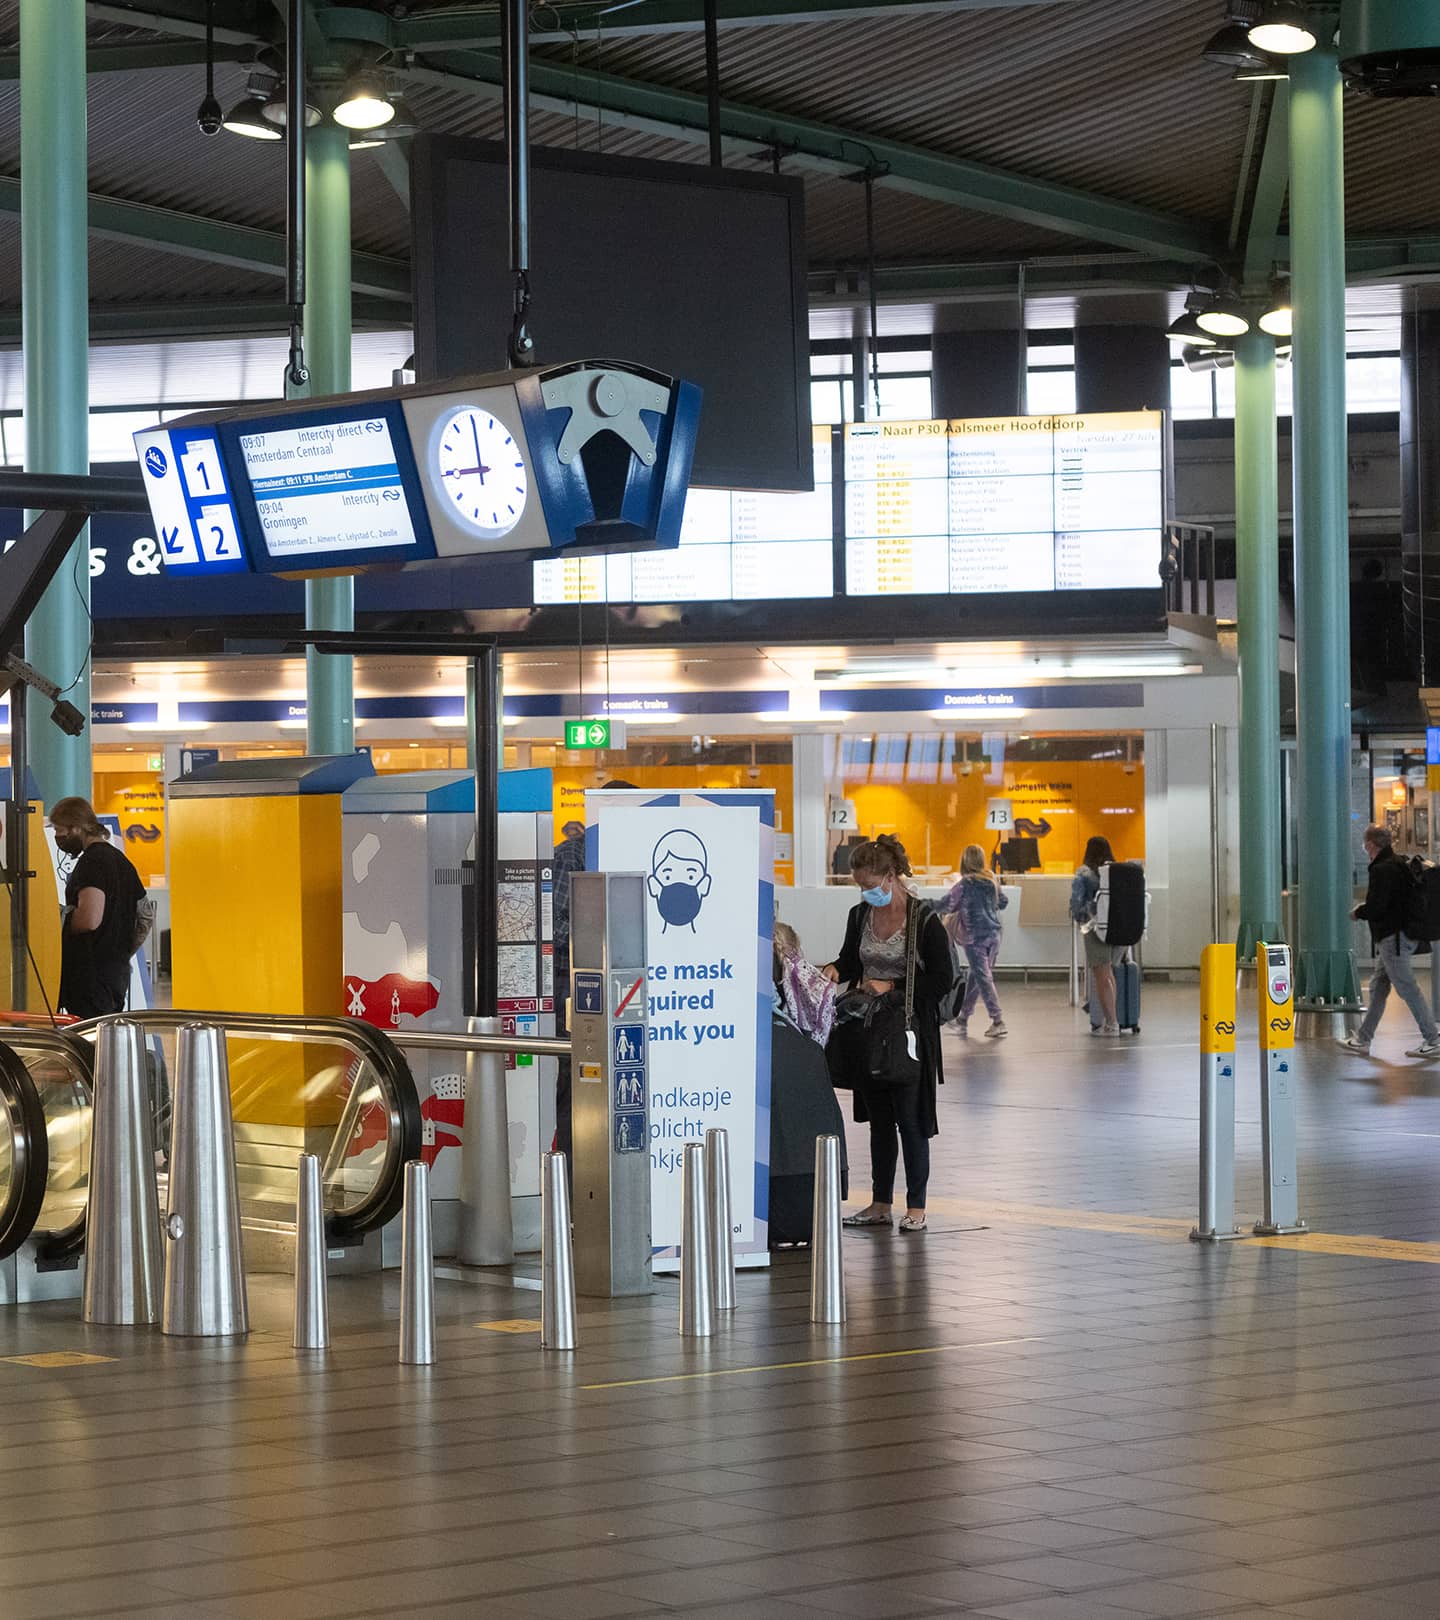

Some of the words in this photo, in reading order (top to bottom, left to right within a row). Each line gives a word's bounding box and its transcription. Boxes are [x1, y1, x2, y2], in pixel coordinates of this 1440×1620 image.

[242, 436, 265, 448] 09:07
[298, 427, 335, 442] Intercity
[337, 424, 362, 437] direct
[883, 426, 913, 436] Naar
[918, 424, 940, 434] P30
[944, 422, 1007, 434] Aalsmeer
[1011, 419, 1084, 431] Hoofddorp
[247, 449, 295, 464] Amsterdam
[297, 442, 334, 458] Centraal
[197, 462, 210, 490] 1
[259, 502, 283, 514] 09:04
[342, 493, 379, 506] Intercity
[263, 516, 308, 530] Groningen
[211, 525, 229, 555] 2
[127, 537, 162, 576] &
[603, 700, 643, 710] Domestic
[644, 699, 668, 709] trains
[944, 694, 987, 704] Domestic
[988, 693, 1014, 704] trains
[832, 810, 847, 823] 12
[990, 810, 1008, 824] 13
[648, 965, 667, 980] ce
[674, 958, 733, 980] mask
[648, 989, 714, 1016] quired
[648, 1020, 687, 1041] ank
[693, 1024, 735, 1045] you
[652, 1086, 732, 1111] ndkapje
[650, 1117, 703, 1139] plicht
